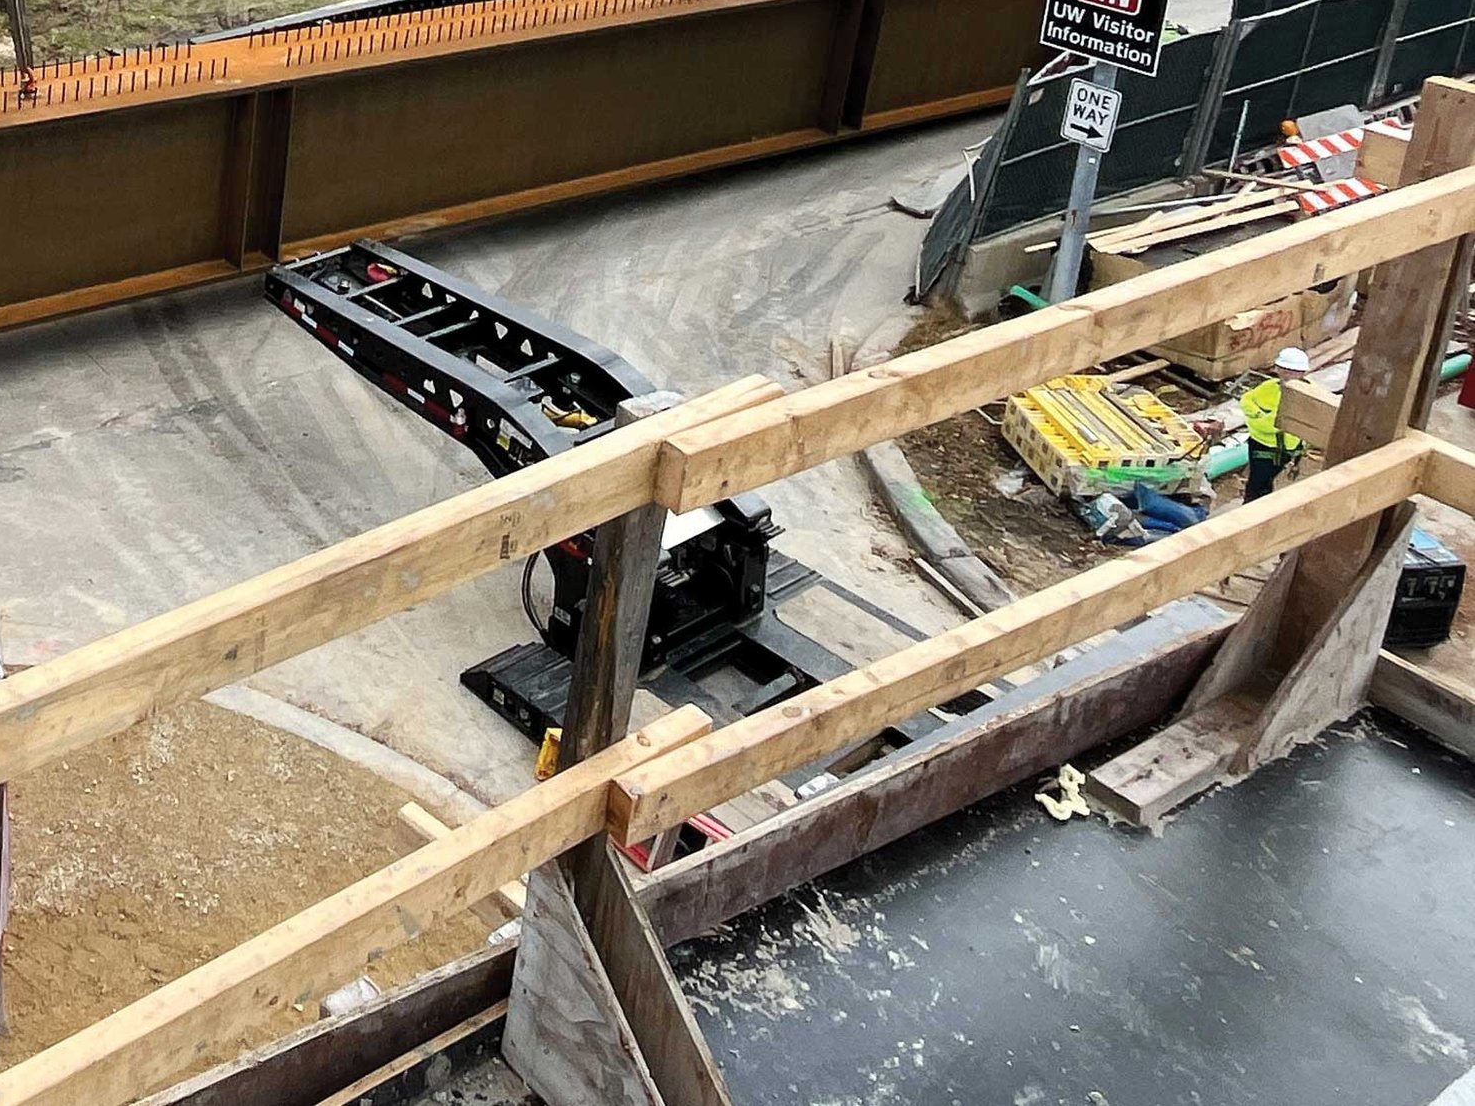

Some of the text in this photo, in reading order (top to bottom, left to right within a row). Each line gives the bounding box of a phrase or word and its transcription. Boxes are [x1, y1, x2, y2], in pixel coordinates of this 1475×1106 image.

[1053, 1, 1155, 43] UW Visitor
[1046, 21, 1152, 66] Information
[1073, 104, 1109, 126] WAY
[1077, 87, 1112, 111] ONE
